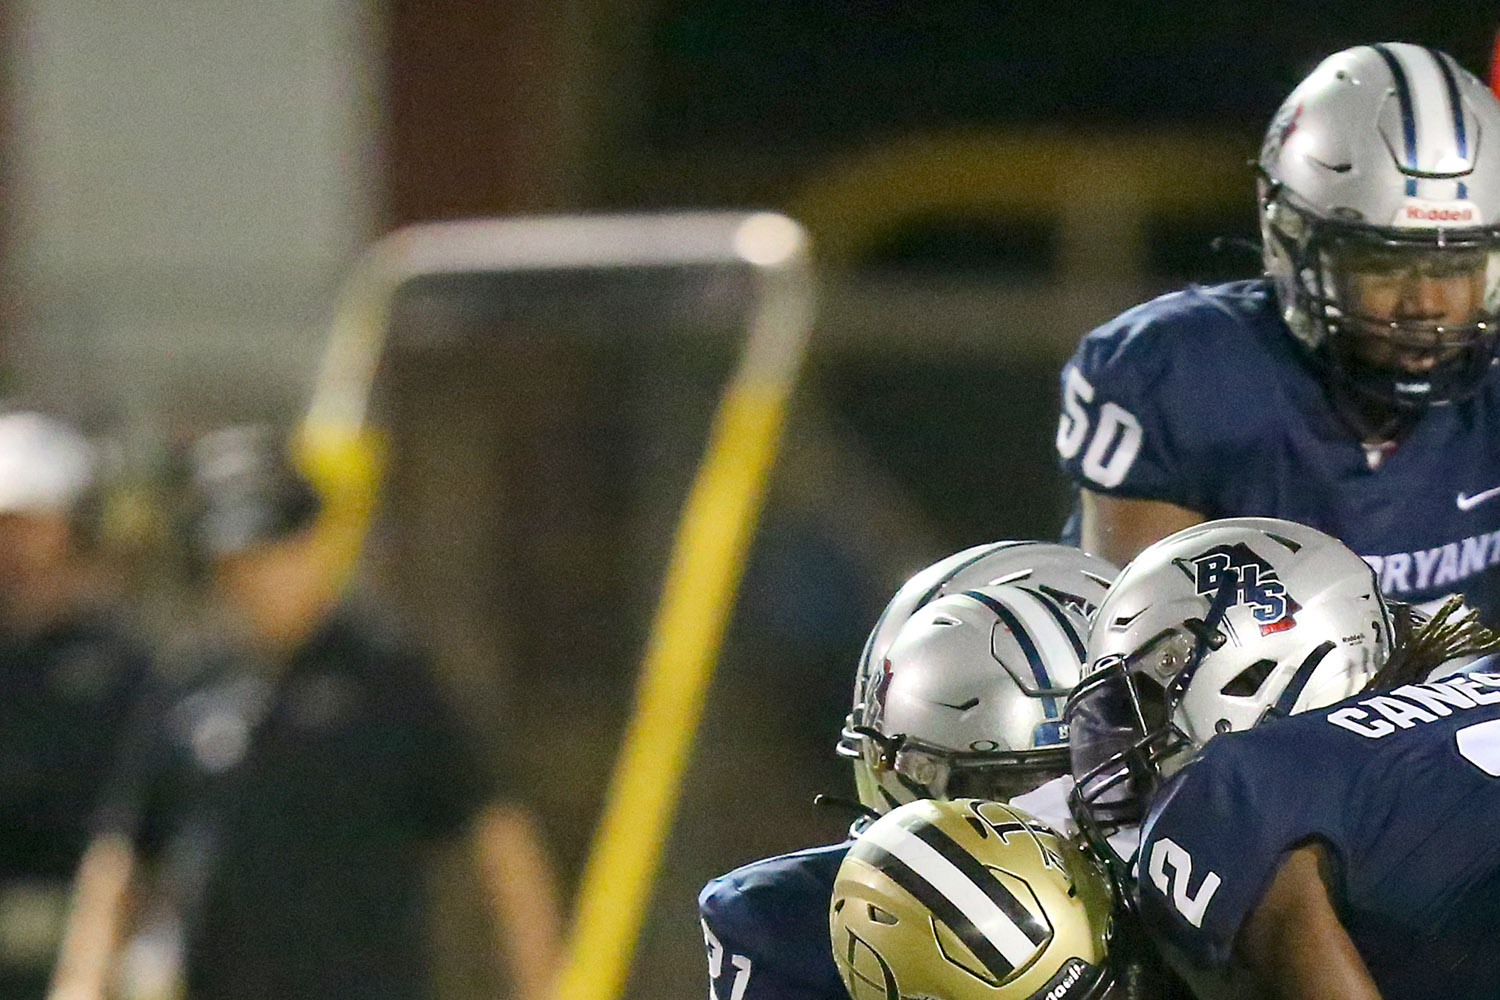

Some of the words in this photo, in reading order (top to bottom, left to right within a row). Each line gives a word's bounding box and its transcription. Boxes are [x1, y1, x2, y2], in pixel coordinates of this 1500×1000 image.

[1057, 366, 1142, 488] 50
[1192, 552, 1286, 625] BHS
[1150, 838, 1222, 928] 2
